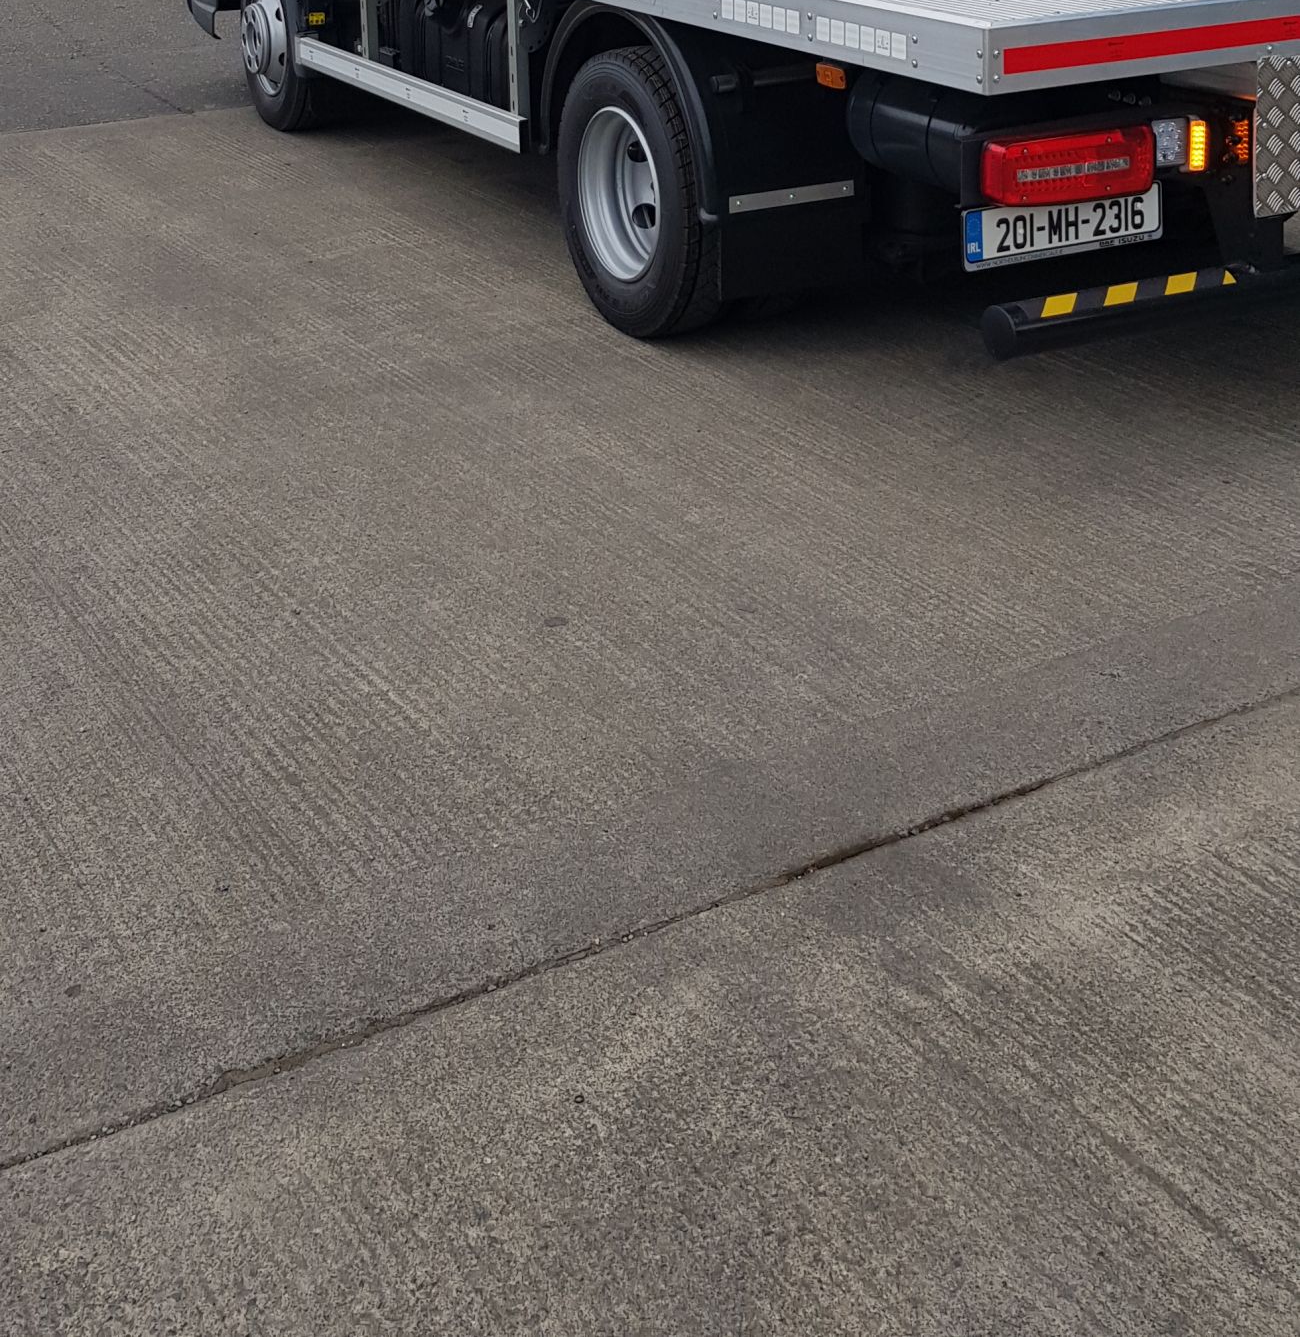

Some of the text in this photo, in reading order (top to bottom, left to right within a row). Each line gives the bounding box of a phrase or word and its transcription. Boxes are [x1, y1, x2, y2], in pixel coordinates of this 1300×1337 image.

[996, 196, 1144, 253] 201-MH-2316
[1119, 234, 1145, 245] ISUZU
[967, 242, 980, 254] IRL
